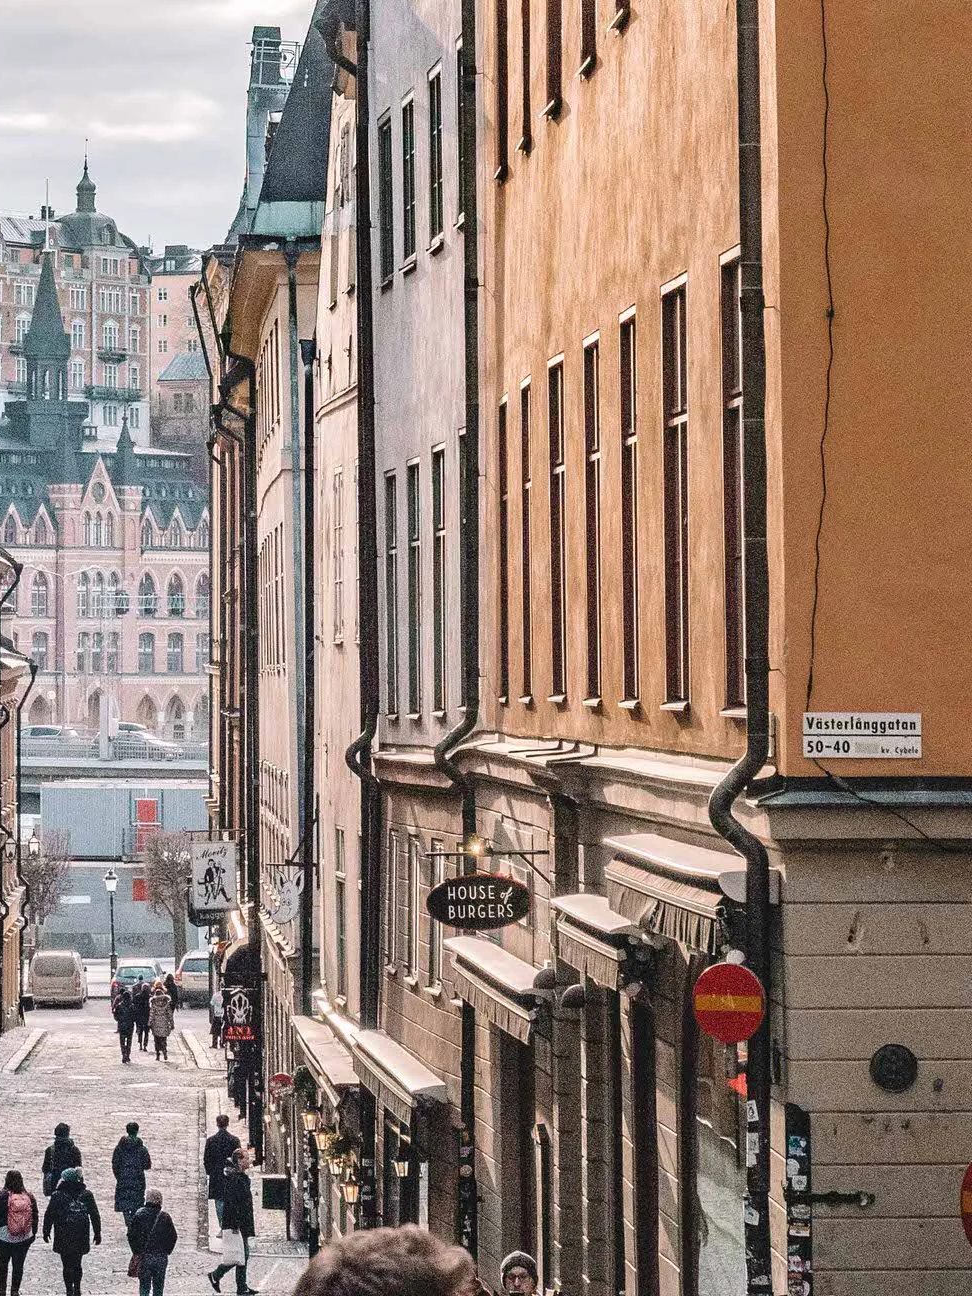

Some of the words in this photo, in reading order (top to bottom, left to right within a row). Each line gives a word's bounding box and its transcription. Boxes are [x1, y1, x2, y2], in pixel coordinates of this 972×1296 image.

[806, 716, 917, 734] Västerlånggatan
[806, 740, 851, 754] 50-40
[894, 746, 919, 756] Cybele
[448, 885, 495, 900] HOUSE
[499, 886, 513, 905] of
[448, 903, 514, 919] BURGERS
